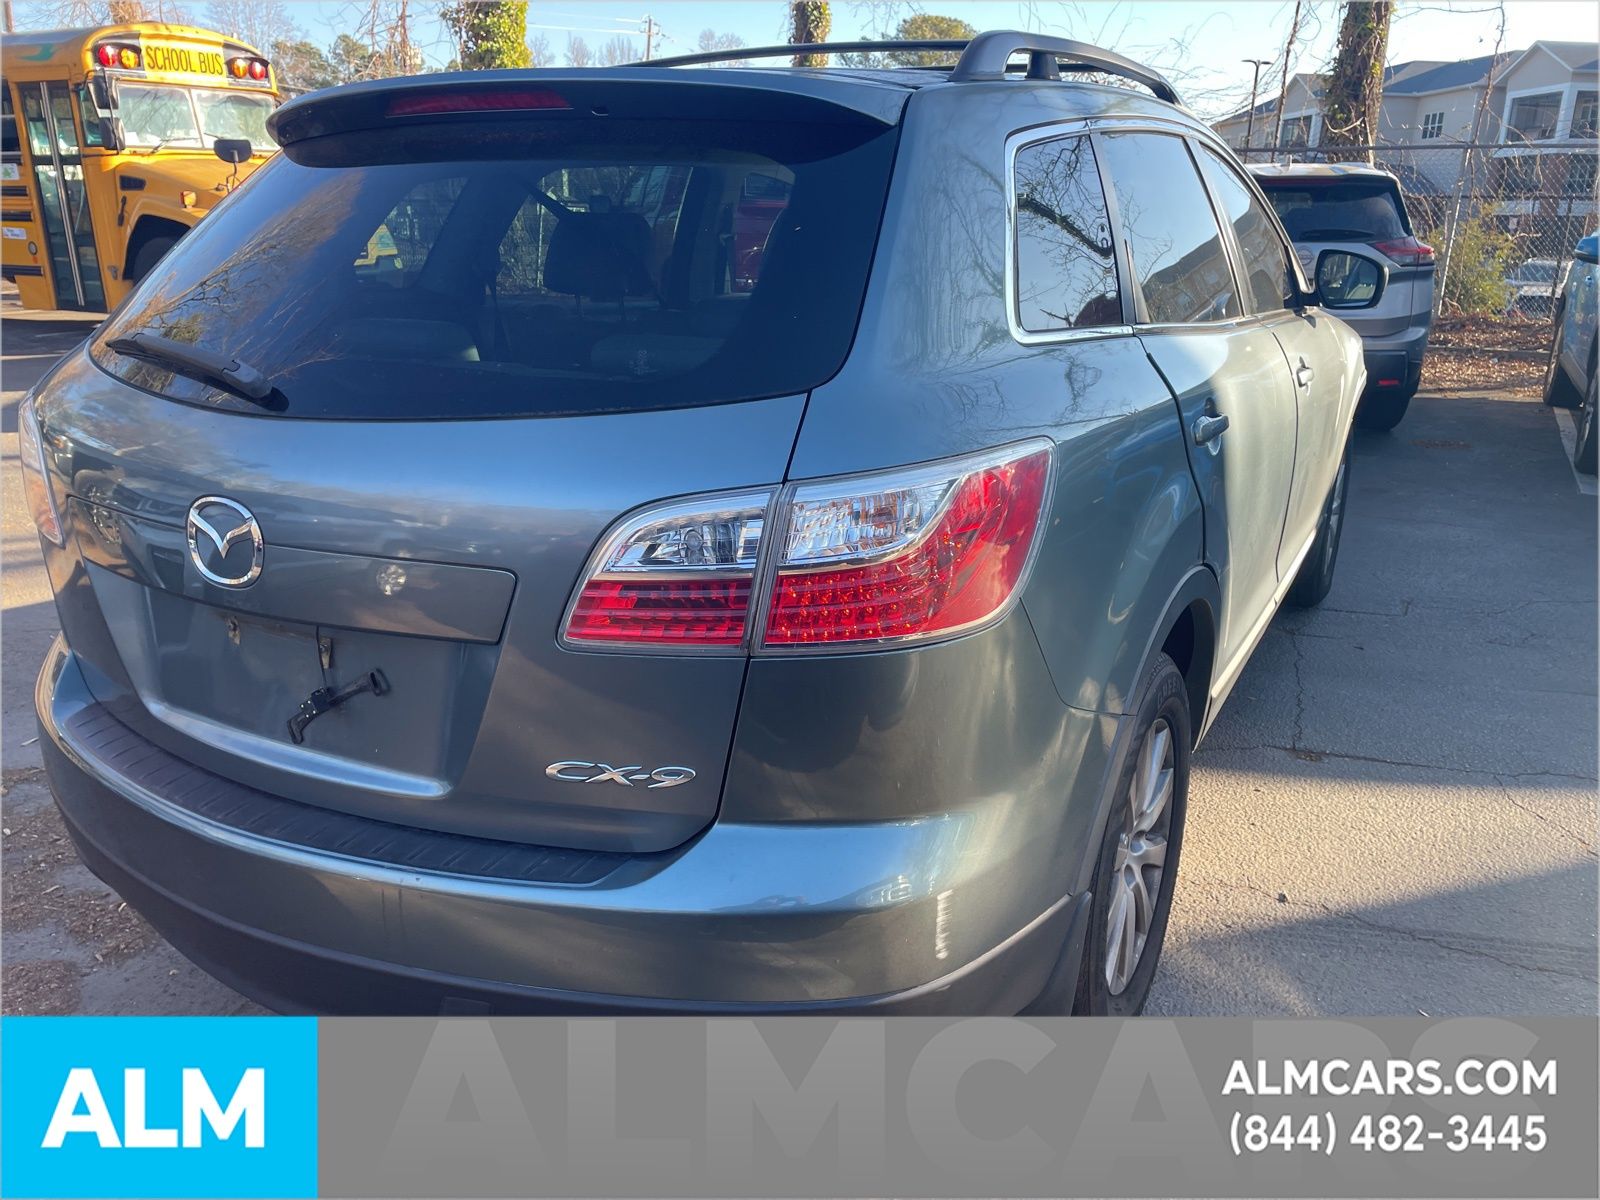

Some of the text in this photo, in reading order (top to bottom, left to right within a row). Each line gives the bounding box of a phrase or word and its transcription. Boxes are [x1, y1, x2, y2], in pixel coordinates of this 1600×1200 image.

[146, 45, 224, 76] SCHOOL BUS
[545, 760, 697, 789] CX-9
